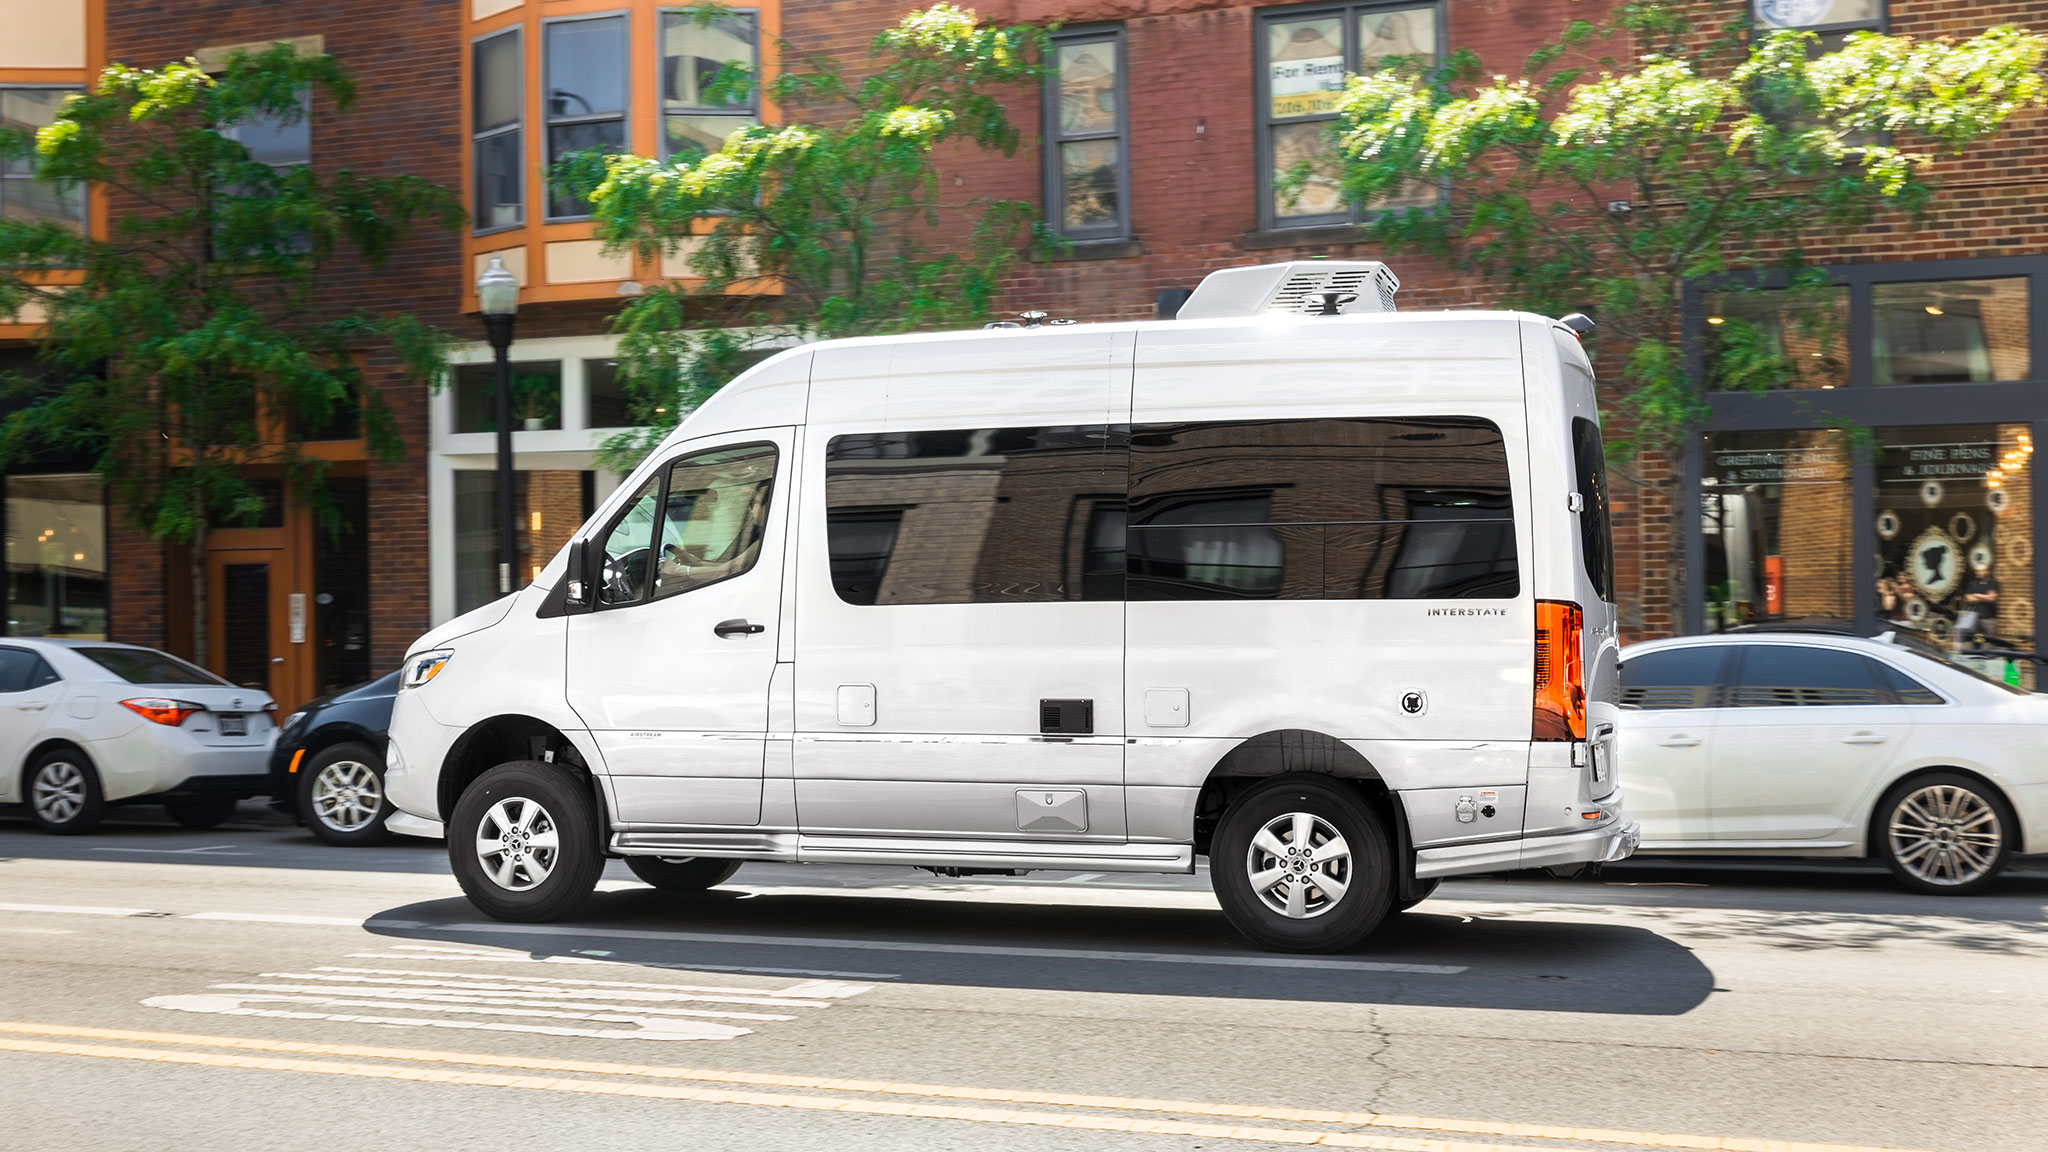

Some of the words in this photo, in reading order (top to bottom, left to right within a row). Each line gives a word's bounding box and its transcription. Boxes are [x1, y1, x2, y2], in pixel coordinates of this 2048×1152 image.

[1272, 66, 1299, 79] For
[1304, 63, 1344, 76] Rent
[1716, 454, 1787, 466] GREETING
[1790, 453, 1839, 464] CARDS
[1910, 449, 1947, 460] FINE
[1950, 448, 1991, 459] PENS
[1726, 470, 1738, 479] &
[1740, 468, 1825, 480] STATIONERY
[1903, 465, 1915, 475] &
[1918, 462, 1998, 475] JOURNALS
[1427, 608, 1508, 616] INTERSTATE
